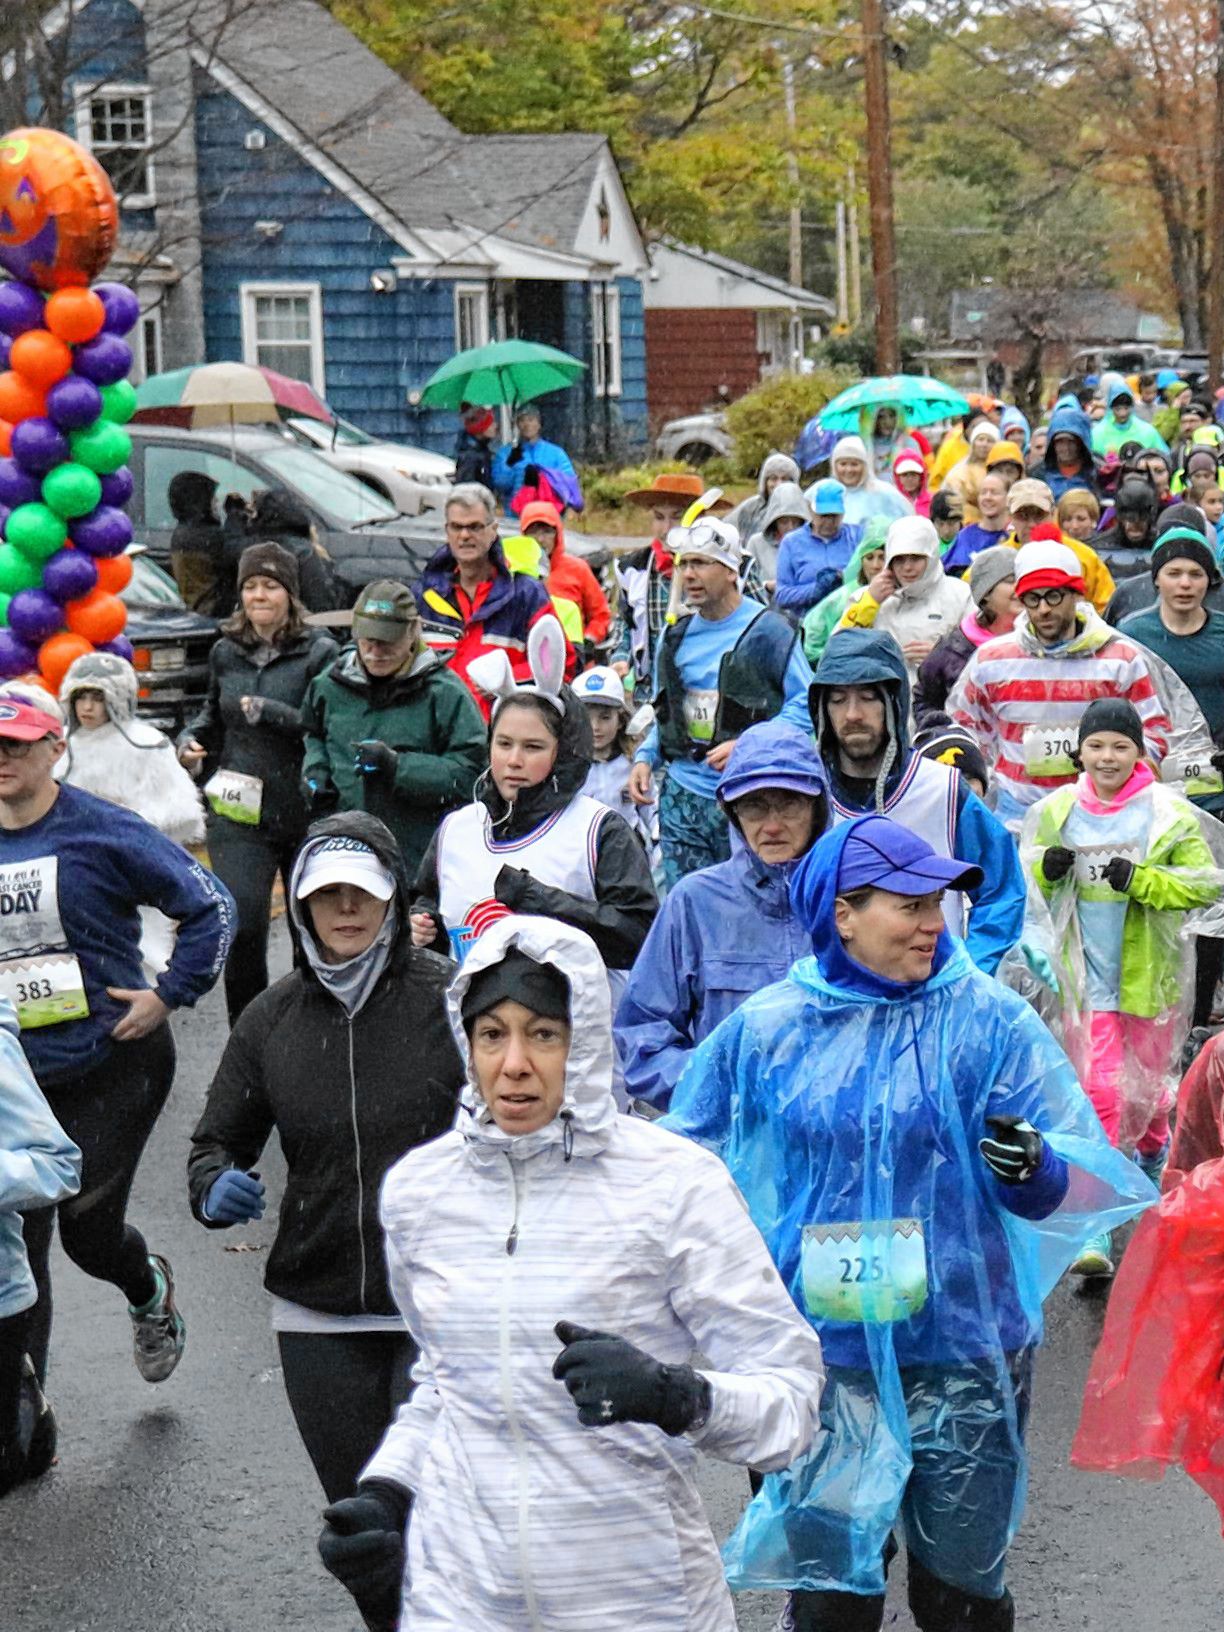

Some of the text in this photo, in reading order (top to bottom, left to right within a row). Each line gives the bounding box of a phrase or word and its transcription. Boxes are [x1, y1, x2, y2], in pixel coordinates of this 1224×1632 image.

[1044, 739, 1071, 756] 370
[1184, 763, 1201, 777] 60
[222, 788, 242, 802] 164
[0, 889, 42, 915] DAY
[16, 978, 52, 1002] 383
